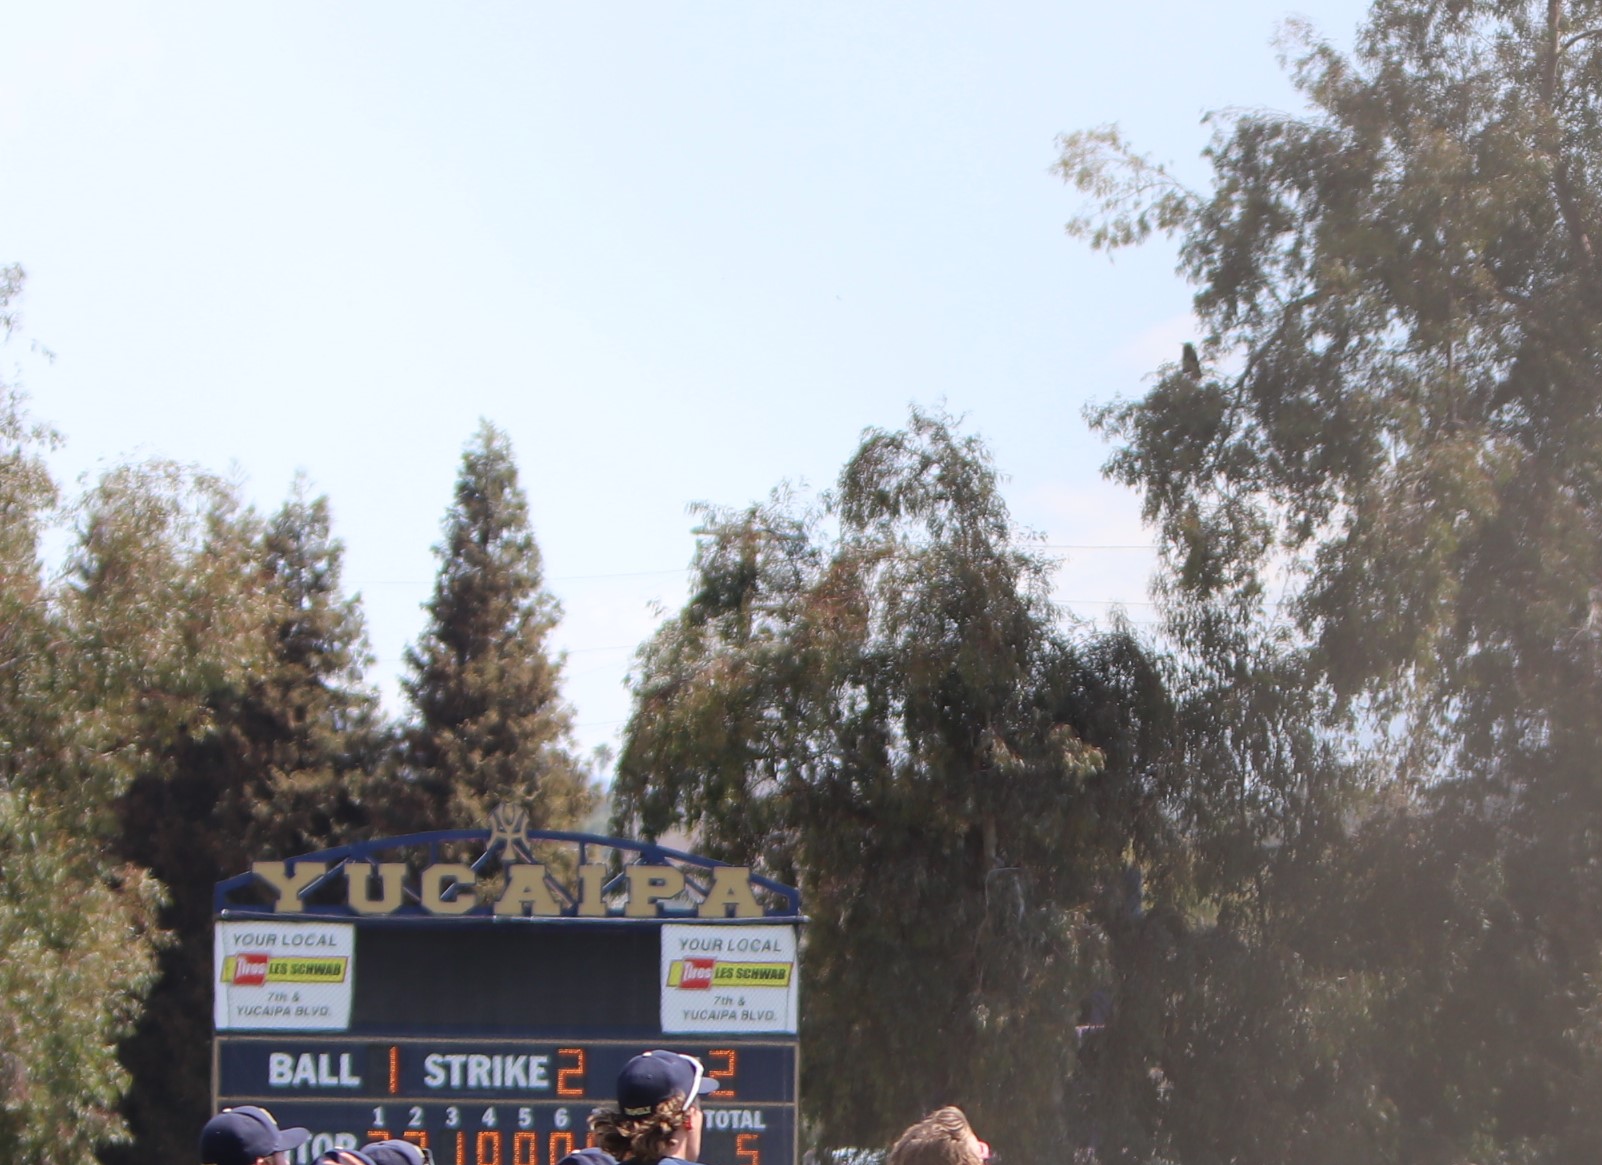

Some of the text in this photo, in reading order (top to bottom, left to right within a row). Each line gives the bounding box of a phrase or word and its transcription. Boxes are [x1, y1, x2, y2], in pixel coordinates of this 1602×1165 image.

[252, 861, 765, 918] YUCAIPA
[233, 933, 337, 947] YOUR LOCAL
[679, 938, 782, 951] YOUR LOCAL
[269, 962, 341, 976] LES SCHWAB
[715, 967, 786, 980] LES SCHWAB
[714, 996, 745, 1006] 7th &
[237, 1006, 291, 1017] YUCAIPA
[683, 1010, 737, 1021] YUCAIPA
[268, 1053, 361, 1087] BALL
[424, 1055, 551, 1088] STRIKE
[557, 1048, 584, 1095] 2
[373, 1107, 568, 1127] 1 2 3 4 5 6
[705, 1110, 766, 1129] TOTAL
